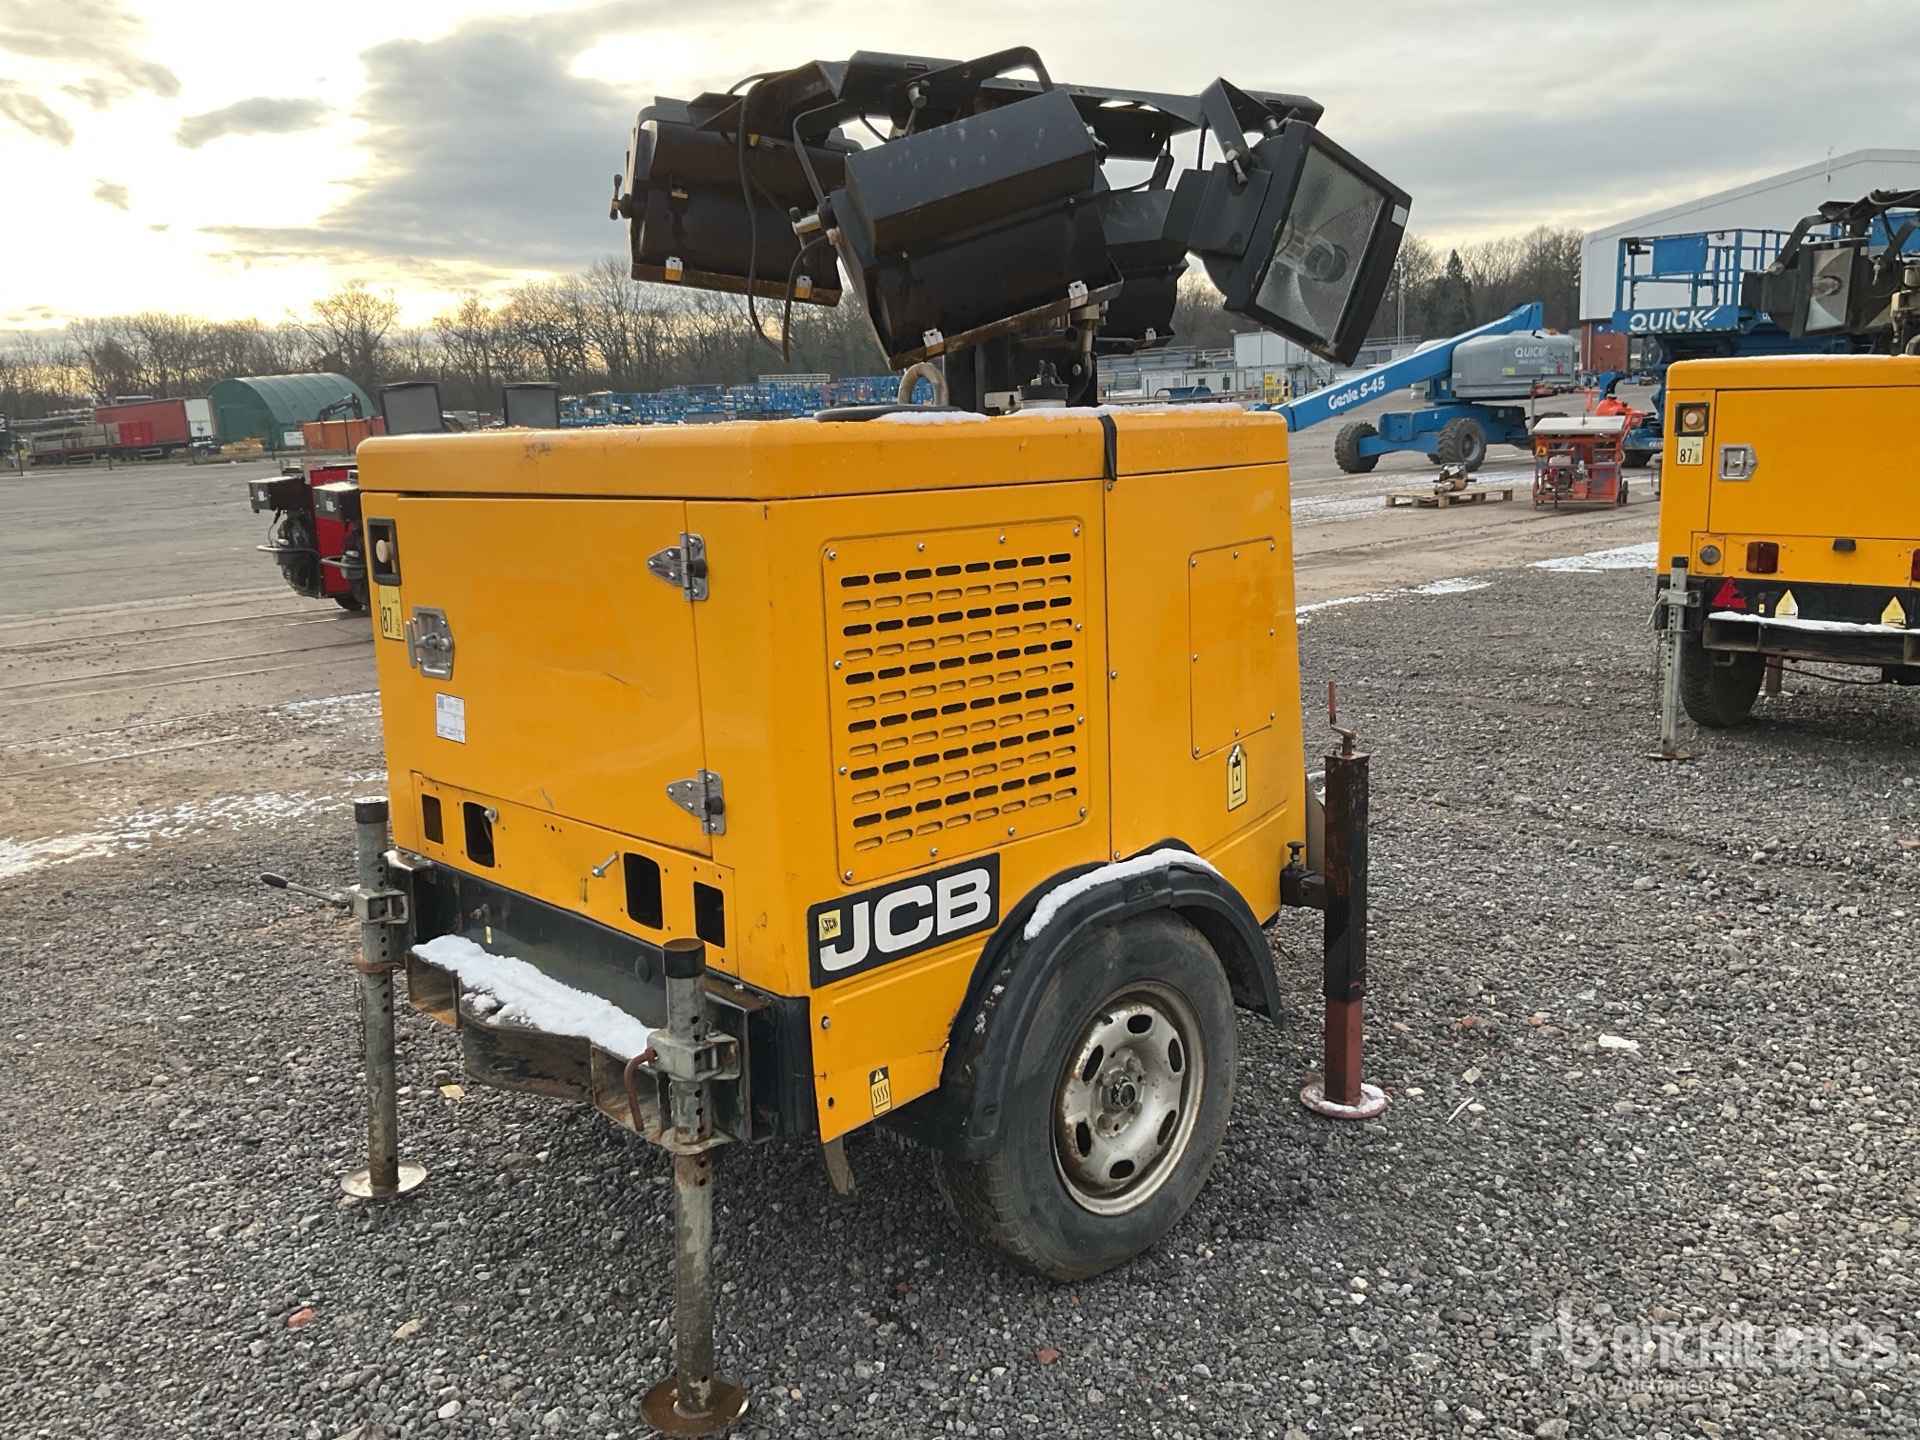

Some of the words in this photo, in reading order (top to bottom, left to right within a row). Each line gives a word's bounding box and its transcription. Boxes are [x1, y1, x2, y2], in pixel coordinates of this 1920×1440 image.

[1628, 306, 1720, 332] QUICK
[1514, 346, 1548, 357] QUICK
[1328, 389, 1359, 410] Genie
[1360, 375, 1386, 398] S-45
[1680, 448, 1692, 463] 87
[382, 606, 392, 633] 87
[819, 867, 991, 972] JCB
[821, 918, 838, 933] JCB
